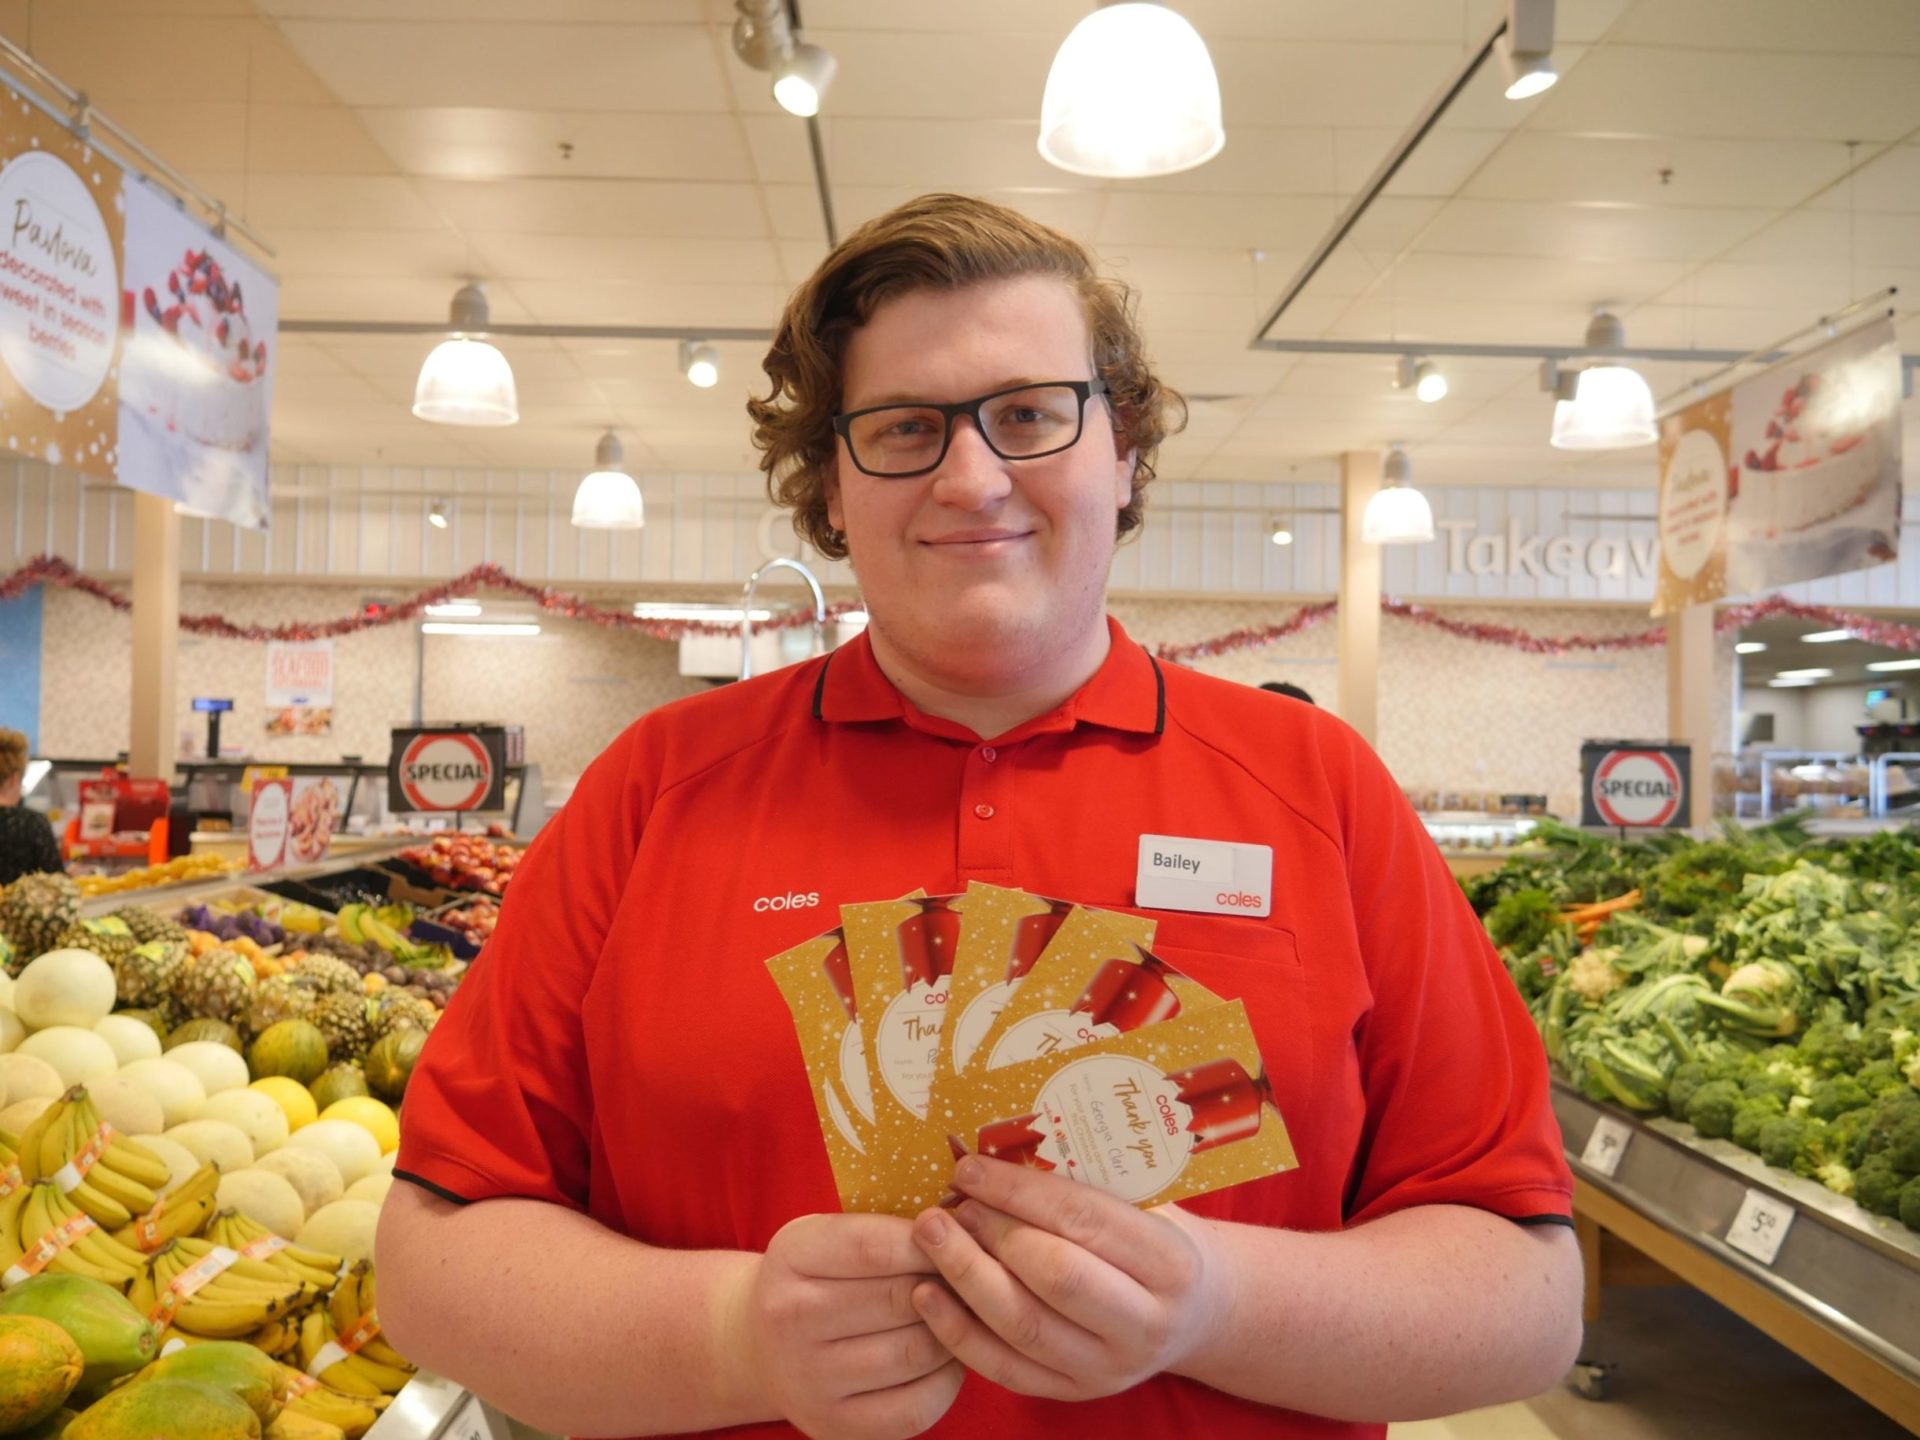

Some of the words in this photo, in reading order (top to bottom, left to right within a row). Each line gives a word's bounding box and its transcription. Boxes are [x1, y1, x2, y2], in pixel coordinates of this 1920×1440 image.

[406, 762, 485, 781] SPECIAL
[1600, 779, 1675, 798] SPECIAL
[1153, 852, 1201, 874] Bailey
[753, 891, 820, 912] coles
[1216, 890, 1263, 908] coles
[1113, 1077, 1152, 1135] Thank
[1156, 1094, 1179, 1136] coles
[1126, 1138, 1158, 1169] you
